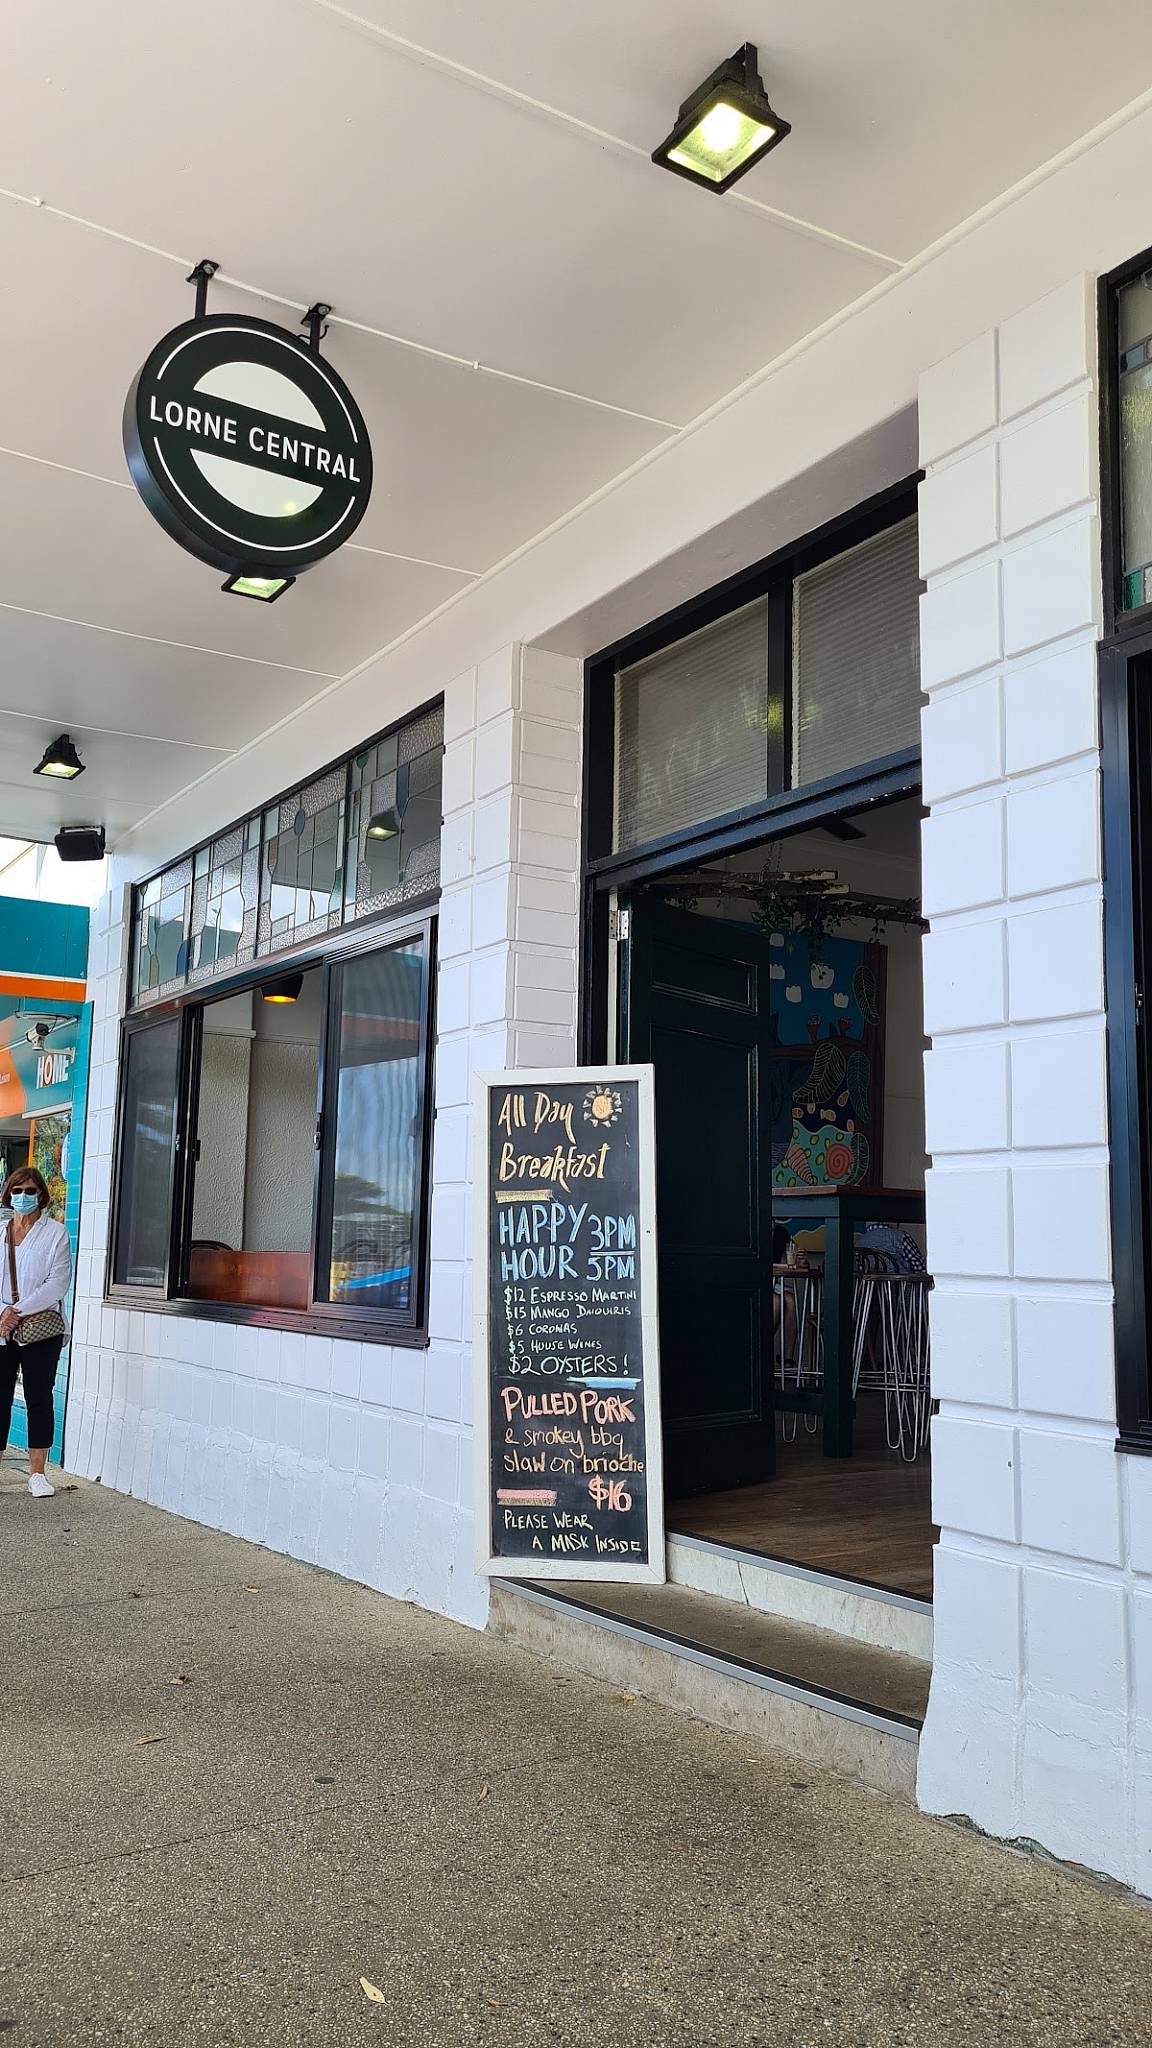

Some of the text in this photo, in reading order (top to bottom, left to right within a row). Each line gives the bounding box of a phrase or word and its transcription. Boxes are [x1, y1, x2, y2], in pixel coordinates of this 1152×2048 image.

[150, 395, 361, 483] LORNE CENTRAL
[36, 1054, 69, 1088] HOME
[498, 1091, 576, 1144] All Day
[500, 1142, 611, 1193] Breakfast
[500, 1202, 636, 1250] HAPPY 3PM
[501, 1245, 635, 1282] HOUR 5PM
[504, 1285, 637, 1305] $12 ESPRESSO MARTINI
[505, 1304, 527, 1321] $15
[530, 1307, 570, 1321] MANGO
[507, 1322, 578, 1339] $6 CORONAS
[508, 1340, 525, 1354] $5
[508, 1353, 541, 1375] $2
[500, 1386, 636, 1425] PULLED PORK
[504, 1426, 625, 1460] & smokey bbq
[503, 1450, 644, 1474] slaw on brioche
[588, 1474, 633, 1513] $16
[504, 1509, 594, 1531] PLEASE WEAR
[532, 1533, 642, 1554] A MASK INSIDE
